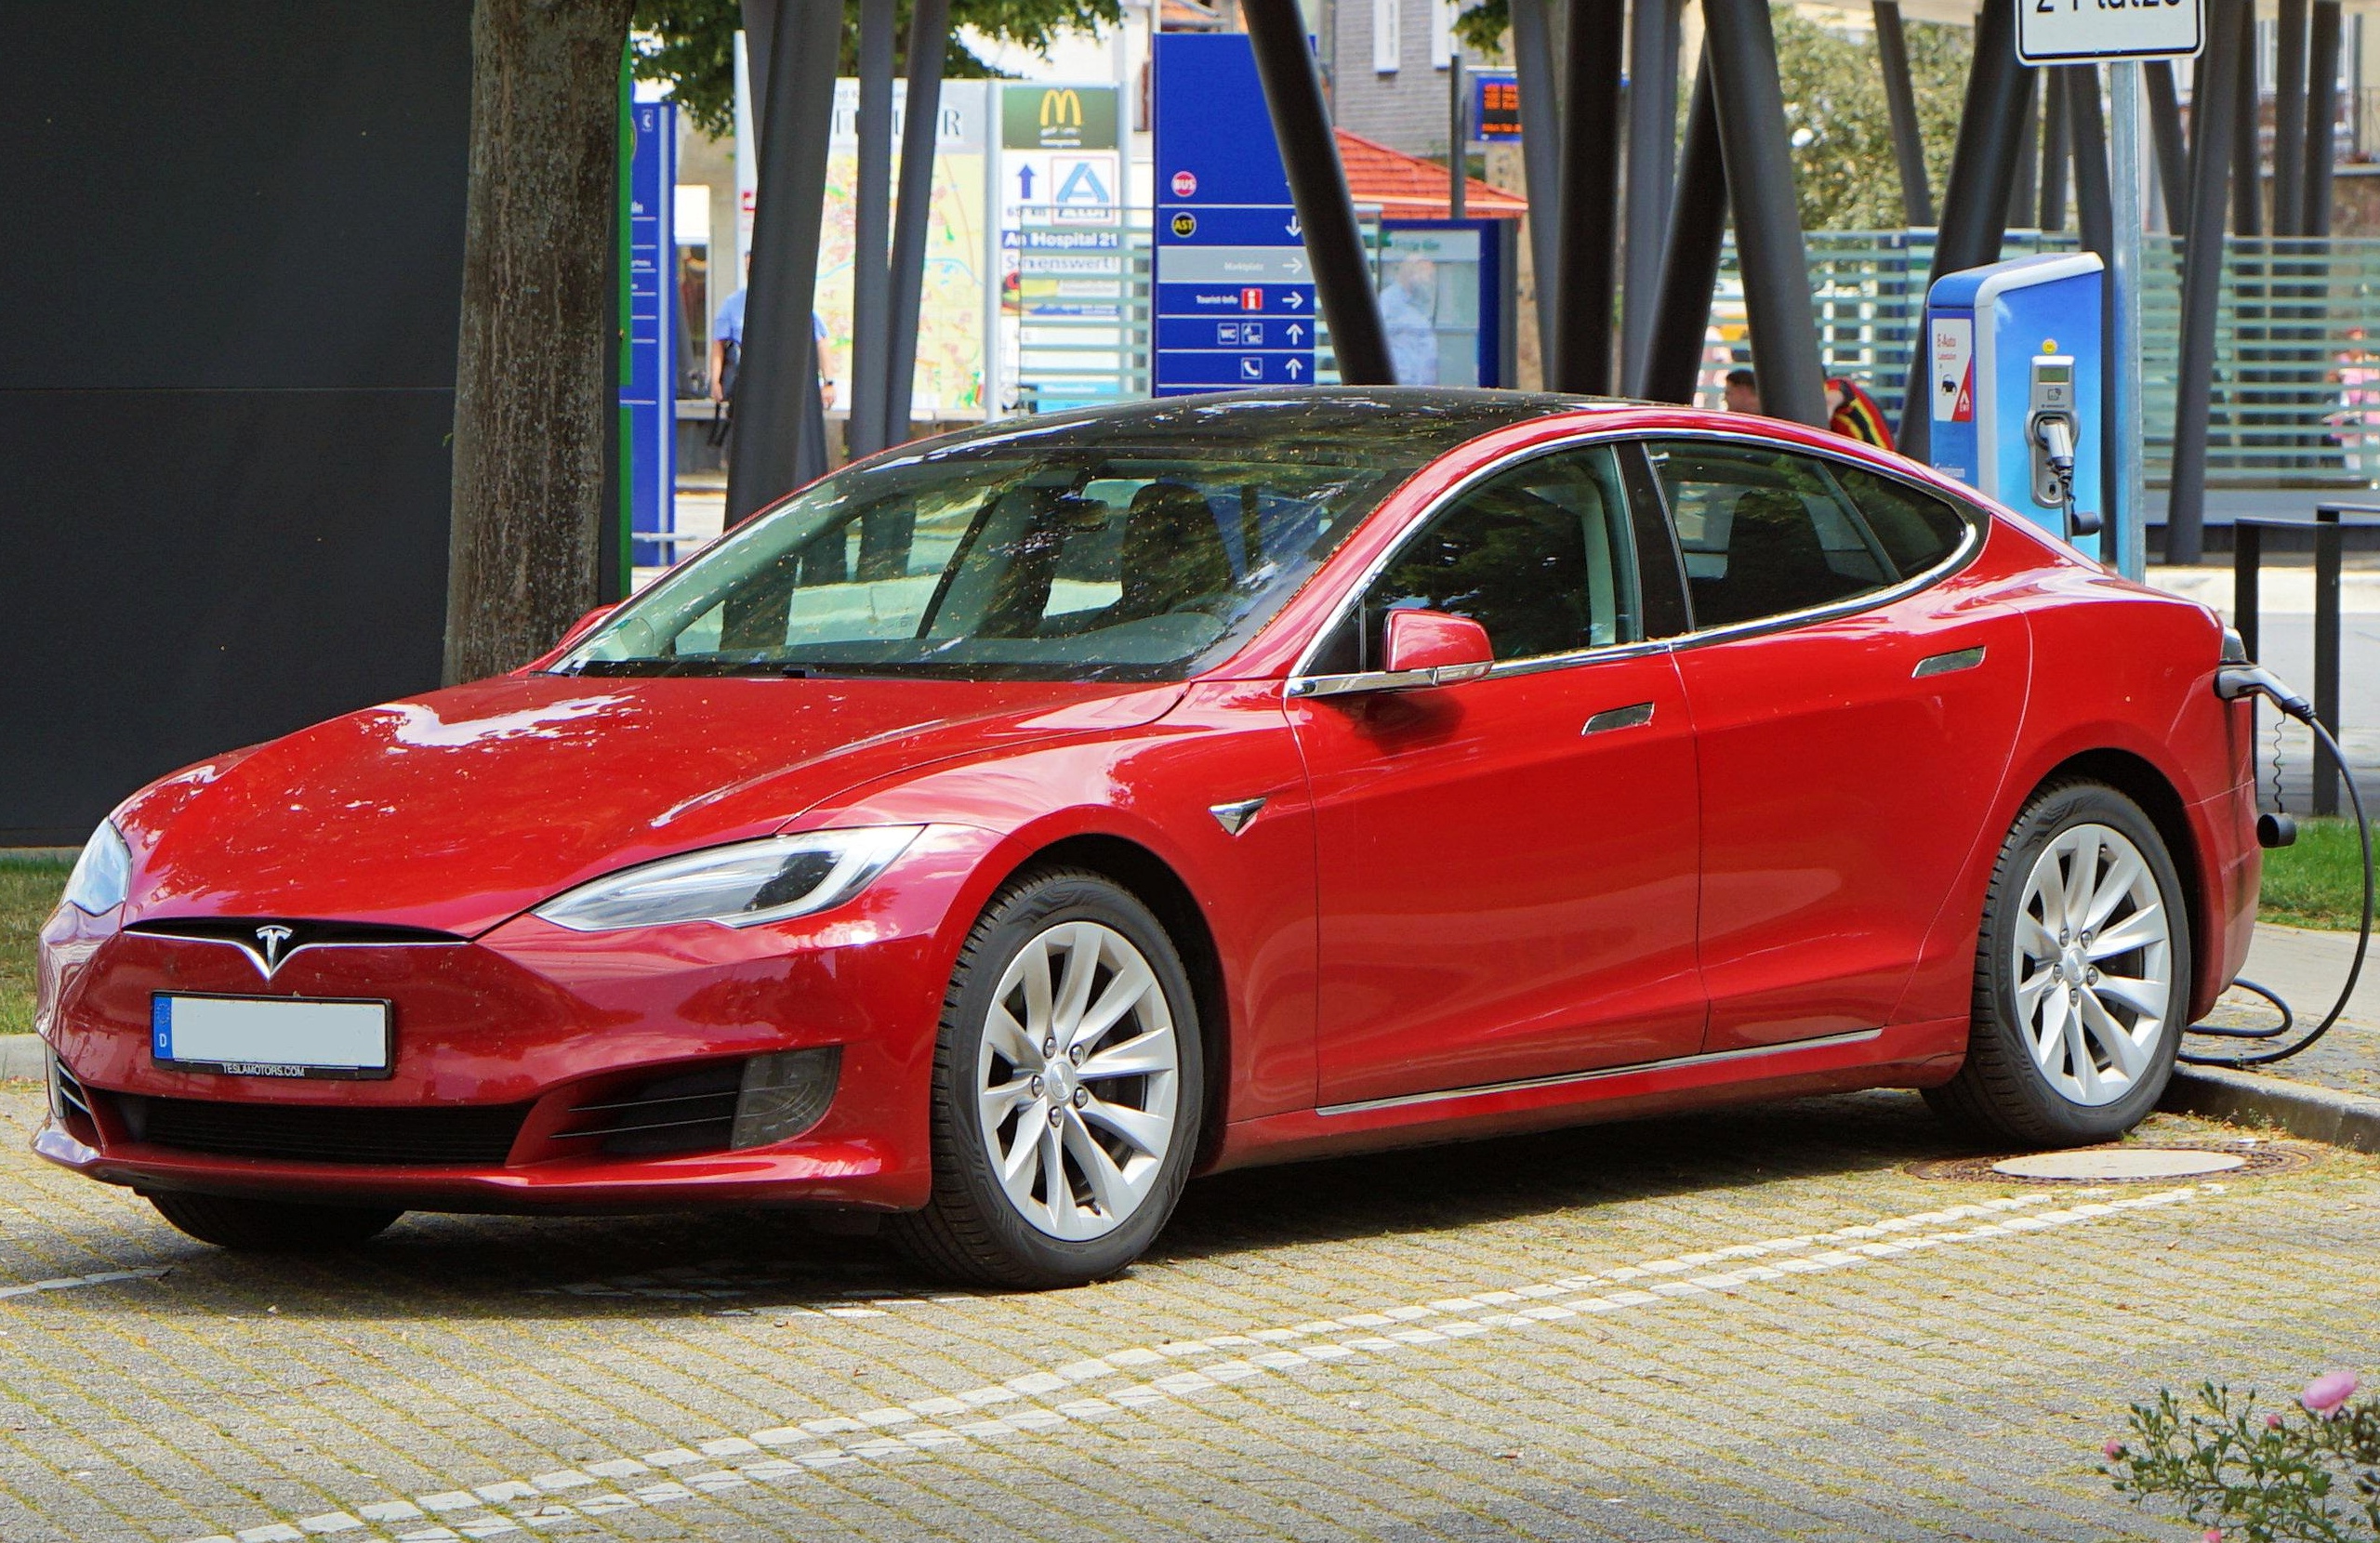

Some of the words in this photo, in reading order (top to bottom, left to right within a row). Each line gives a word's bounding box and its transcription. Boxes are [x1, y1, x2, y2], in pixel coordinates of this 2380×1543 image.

[1173, 179, 1196, 191] BUS
[1174, 219, 1194, 231] AST
[1030, 231, 1097, 248] Hospital
[1099, 231, 1117, 246] 21
[1221, 329, 1237, 339] WC
[159, 1034, 167, 1048] D
[223, 1062, 305, 1076] TESLAMOTORS.COM
